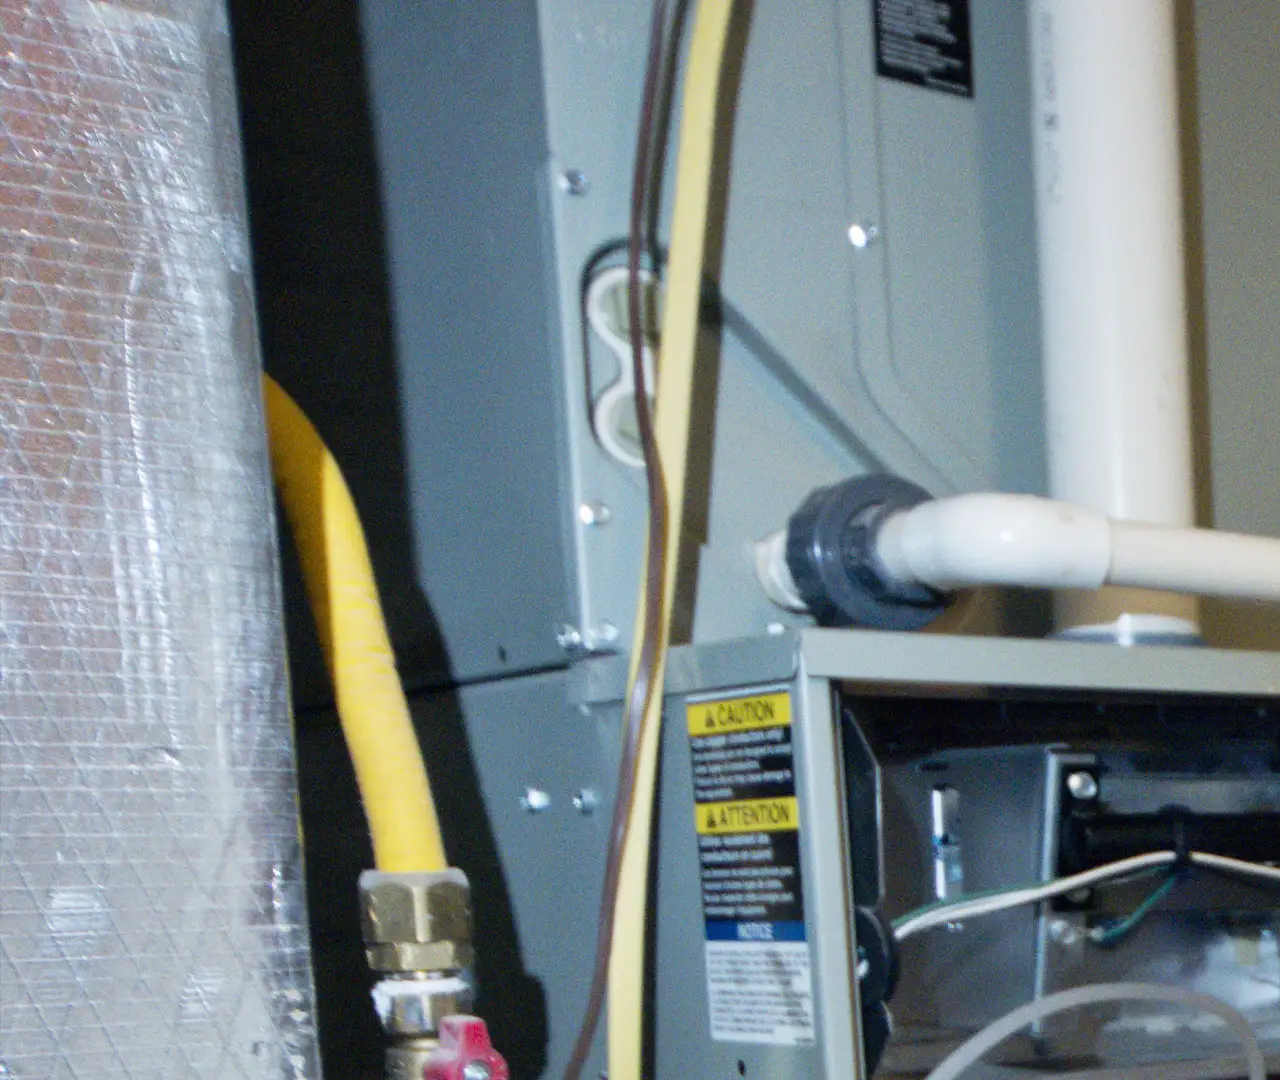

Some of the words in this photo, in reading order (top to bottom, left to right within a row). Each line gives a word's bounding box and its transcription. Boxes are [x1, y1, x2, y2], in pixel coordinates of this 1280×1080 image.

[718, 700, 775, 727] CAUTION
[720, 801, 790, 827] ATTENTION
[737, 921, 774, 940] NOTICE
